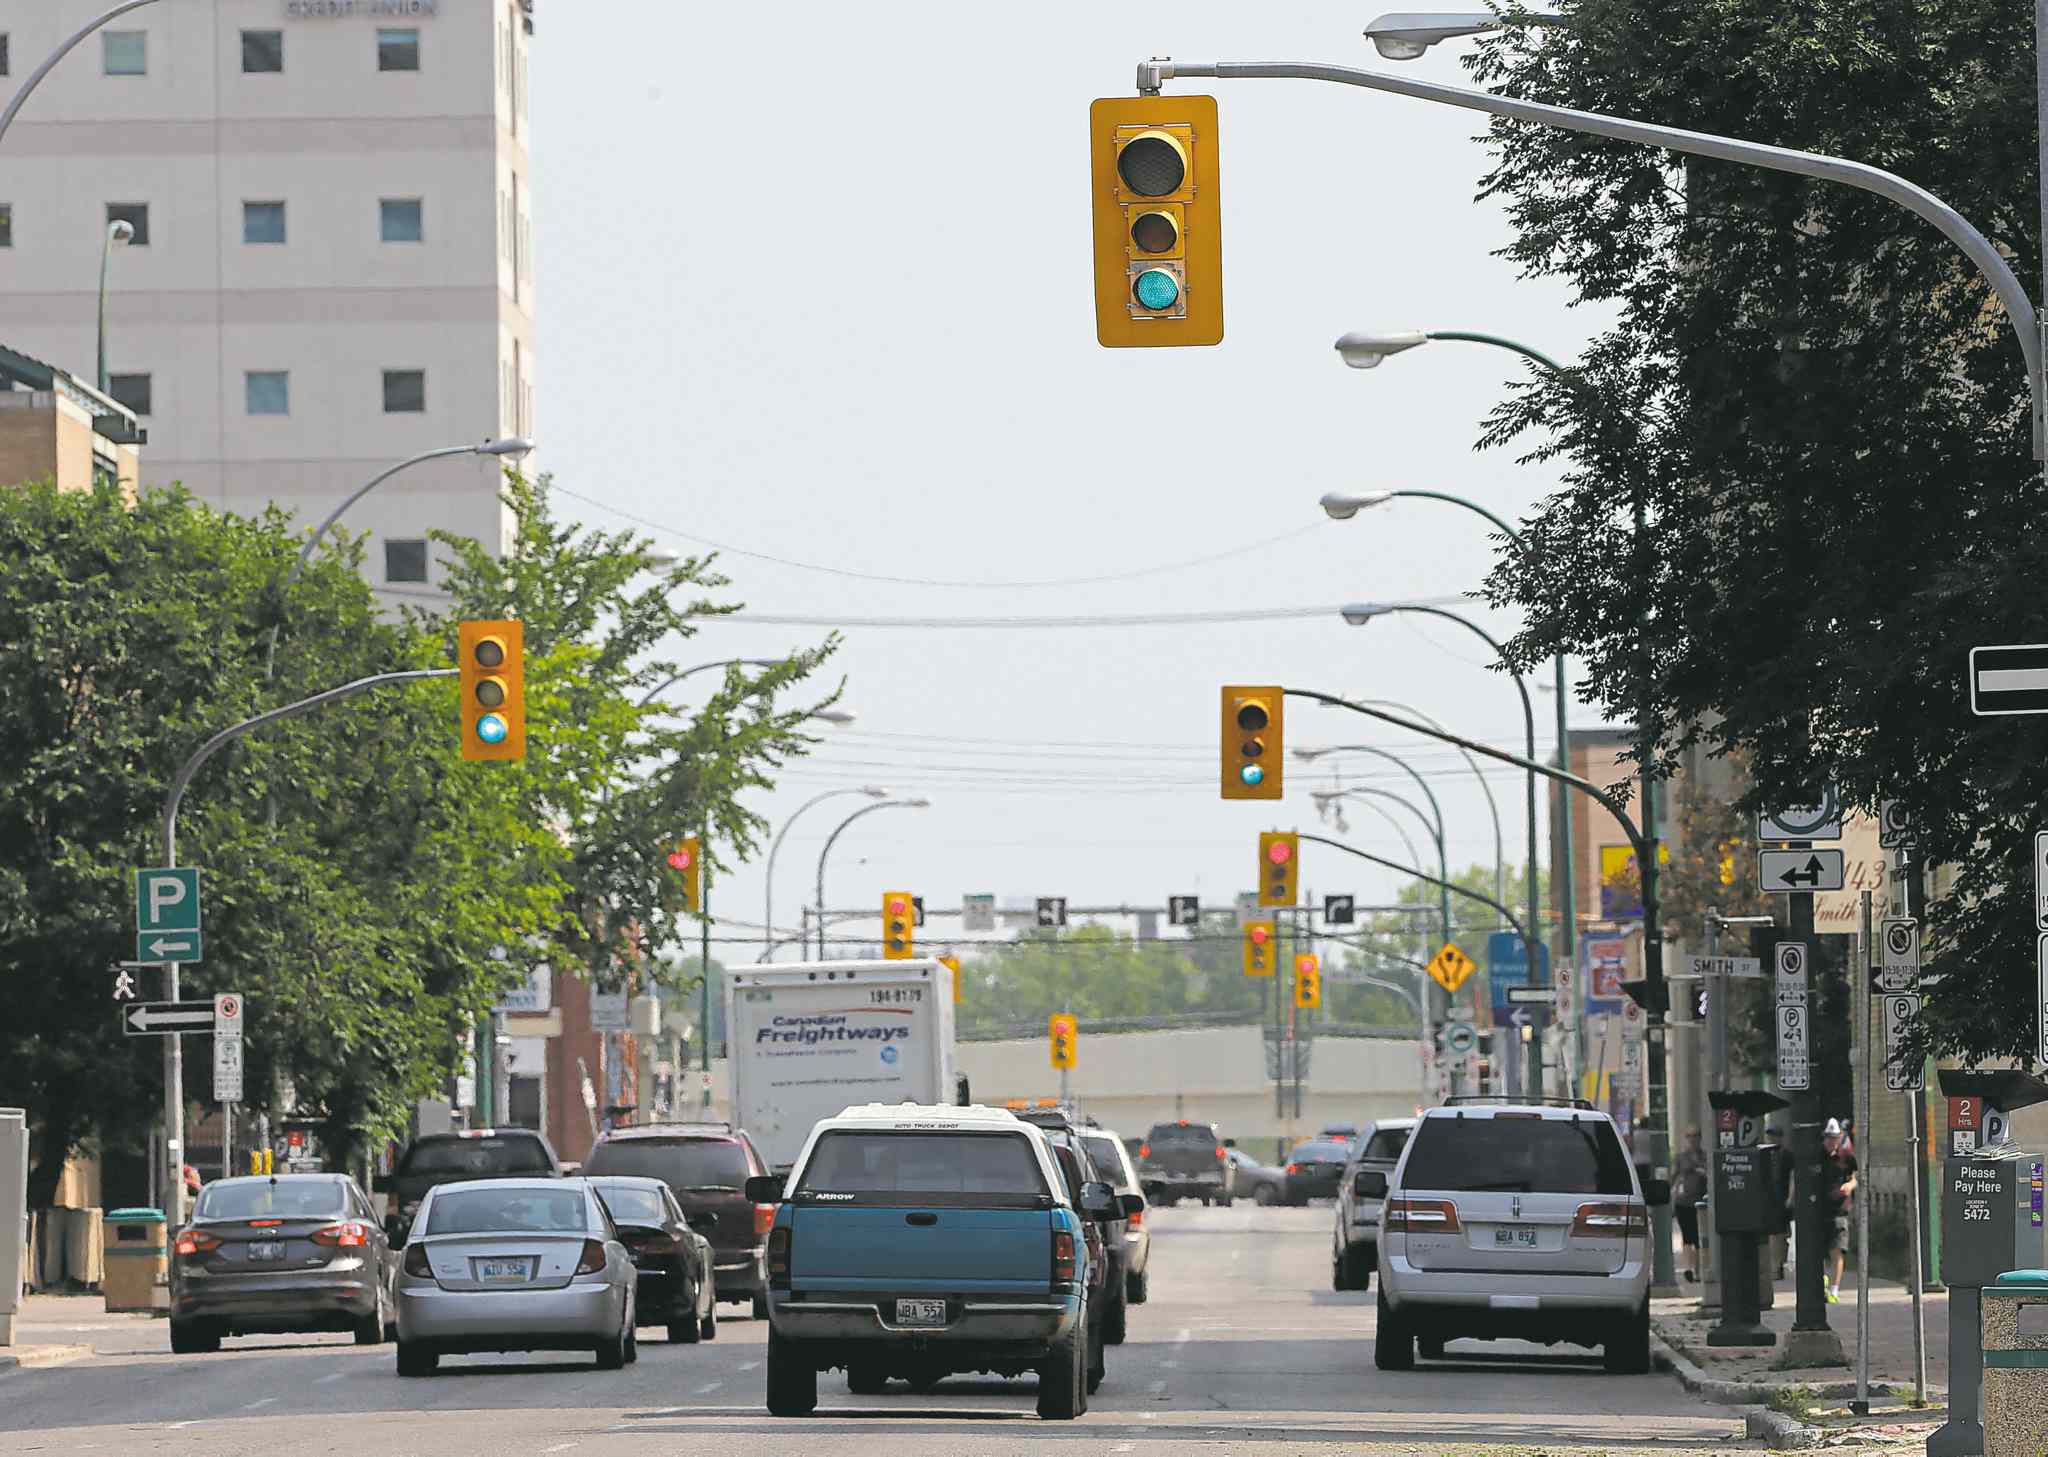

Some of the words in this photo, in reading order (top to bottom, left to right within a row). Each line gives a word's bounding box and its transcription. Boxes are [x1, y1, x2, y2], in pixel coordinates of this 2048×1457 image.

[149, 876, 187, 924] P
[1693, 958, 1734, 974] SMITH
[772, 1015, 847, 1027] Canadian
[755, 1026, 910, 1044] Freightways
[1959, 1099, 1971, 1116] 2
[1957, 1117, 1973, 1126] Hrs
[1986, 1116, 2003, 1147] P
[1960, 1166, 1997, 1179] Please
[1954, 1180, 1974, 1196] Pay
[1976, 1180, 2002, 1193] Here
[815, 1192, 856, 1201] ARROW
[1963, 1208, 1991, 1221] 5472
